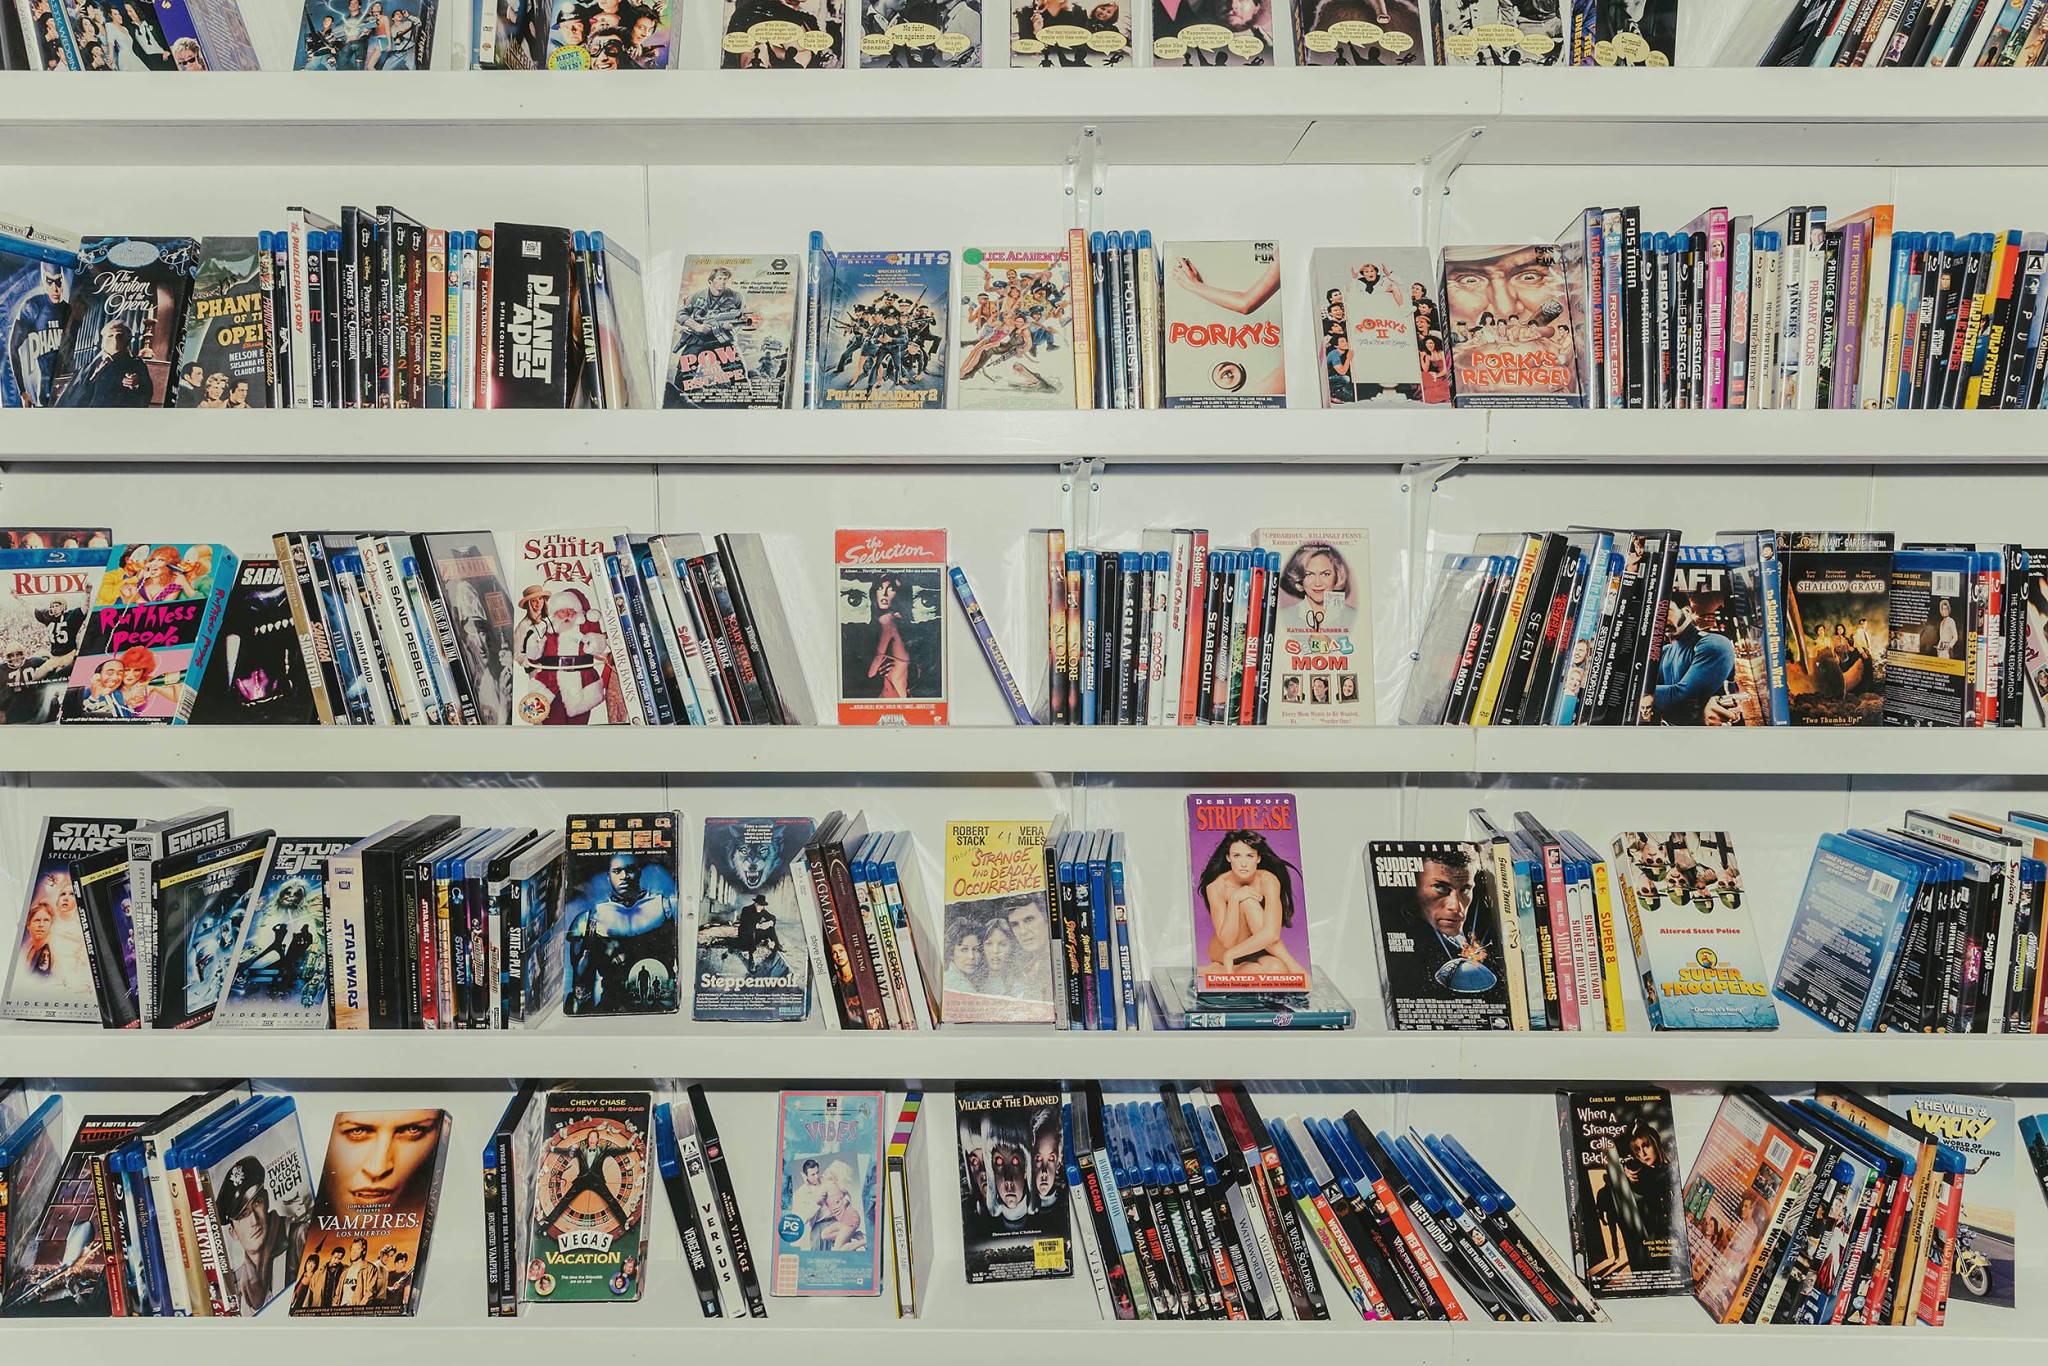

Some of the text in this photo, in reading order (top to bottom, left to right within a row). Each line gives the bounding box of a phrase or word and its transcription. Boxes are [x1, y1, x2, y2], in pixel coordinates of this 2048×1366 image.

[891, 33, 902, 41] Two
[904, 33, 923, 42] against
[898, 252, 950, 265] HITS
[1255, 253, 1274, 262] FOX
[1626, 217, 1637, 289] POSTMAN
[93, 276, 153, 295] Phantom
[104, 294, 158, 319] Opera
[1659, 271, 1668, 352] PREDATOR
[528, 274, 560, 383] PLANET
[1124, 281, 1137, 372] POLTERGEIST
[1355, 318, 1407, 334] PORKY'S
[1375, 329, 1389, 339] II
[1805, 280, 1819, 366] PRIMARY COLORS
[507, 303, 532, 378] APES
[1169, 321, 1280, 350] PORKY'S
[229, 350, 258, 362] NELSON
[429, 314, 442, 386] PITCH BLACK
[1473, 350, 1557, 369] PORKY'S
[380, 368, 389, 378] 2
[398, 359, 407, 369] 2
[413, 365, 421, 374] 3
[682, 370, 744, 391] ESCAPE
[1461, 368, 1569, 386] REVENGE!
[826, 389, 938, 400] POLICE ACADEMY 2
[524, 536, 604, 560] Santa
[544, 534, 576, 543] The
[866, 536, 883, 549] the
[841, 544, 934, 566] Seduction
[13, 573, 88, 595] RUDY
[1798, 582, 1885, 591] SHALLOW GRAVE
[100, 603, 197, 635] Ruthless
[382, 559, 431, 698] the SAND PEBBLES
[1121, 598, 1133, 659] SCREAM
[112, 627, 179, 659] people
[311, 621, 331, 662] SAHARA
[1104, 631, 1112, 669] SCREAM
[1202, 612, 1218, 694] SEABISCUIT
[1245, 636, 1259, 668] SELMA
[299, 633, 321, 689] SABOTEUR
[354, 630, 372, 683] SAINT MAUD
[373, 639, 388, 673] SALT
[605, 608, 636, 703] SAVING BANKS
[1152, 631, 1163, 682] SCROOGED
[1292, 656, 1348, 670] MOM
[1967, 631, 1977, 684] SHANE
[986, 636, 1024, 708] SCHOOL DAZE
[1259, 633, 1273, 703] SERENITY
[53, 823, 122, 837] STAR
[571, 818, 671, 829] SHAQ
[1197, 805, 1293, 831] STRIPTEASE
[168, 823, 226, 853] EMPIRE
[570, 830, 671, 849] STEEL
[953, 826, 1044, 836] ROBERT VERA
[957, 836, 1046, 846] STACK MILES
[971, 847, 1033, 867] STRANGE
[1375, 857, 1424, 872] SUDDEN
[972, 864, 1038, 880] AND DEADLY
[1377, 872, 1416, 887] DEATH
[2007, 858, 2020, 905] Suspicion
[810, 861, 838, 934] STIGMATA
[953, 876, 1041, 898] OCCURRENCE
[1601, 912, 1616, 963] SUPER 8
[344, 919, 358, 1009] STAR WARS
[455, 936, 465, 985] STARMAN
[1119, 945, 1132, 981] STRIPES
[1572, 920, 1588, 1006] SUNSET BOULEVARD
[701, 973, 799, 991] Steppenwolf
[1679, 968, 1743, 982] SUPER
[1662, 981, 1767, 996] TROOPERS
[958, 1095, 1059, 1111] VILLAGE OF THE DAMNED
[1577, 1108, 1616, 1122] When A
[1915, 1100, 1989, 1117] THE WILD &
[805, 1121, 859, 1143] VIBES
[1583, 1124, 1628, 1136] Stranger
[1906, 1107, 1998, 1141] WACKY
[1590, 1139, 1614, 1149] calls
[267, 1152, 298, 1178] TWELVE
[1582, 1152, 1608, 1164] Back
[272, 1170, 302, 1200] HIGH
[1086, 1173, 1104, 1213] VOLCANO
[317, 1213, 420, 1231] VAMPIRES:
[783, 1222, 799, 1231] PG
[1409, 1200, 1452, 1253] WESTWORLD
[191, 1209, 215, 1271] VALKYRIE
[560, 1232, 609, 1248] VEGAS
[682, 1227, 705, 1271] VENGEANCE
[1169, 1211, 1196, 1276] WARGAMES
[1239, 1218, 1262, 1280] WATERWORLD
[1816, 1230, 1833, 1260] WHIPLASH
[545, 1251, 620, 1264] VACATION
[1259, 1233, 1283, 1293] WATERWORLD
